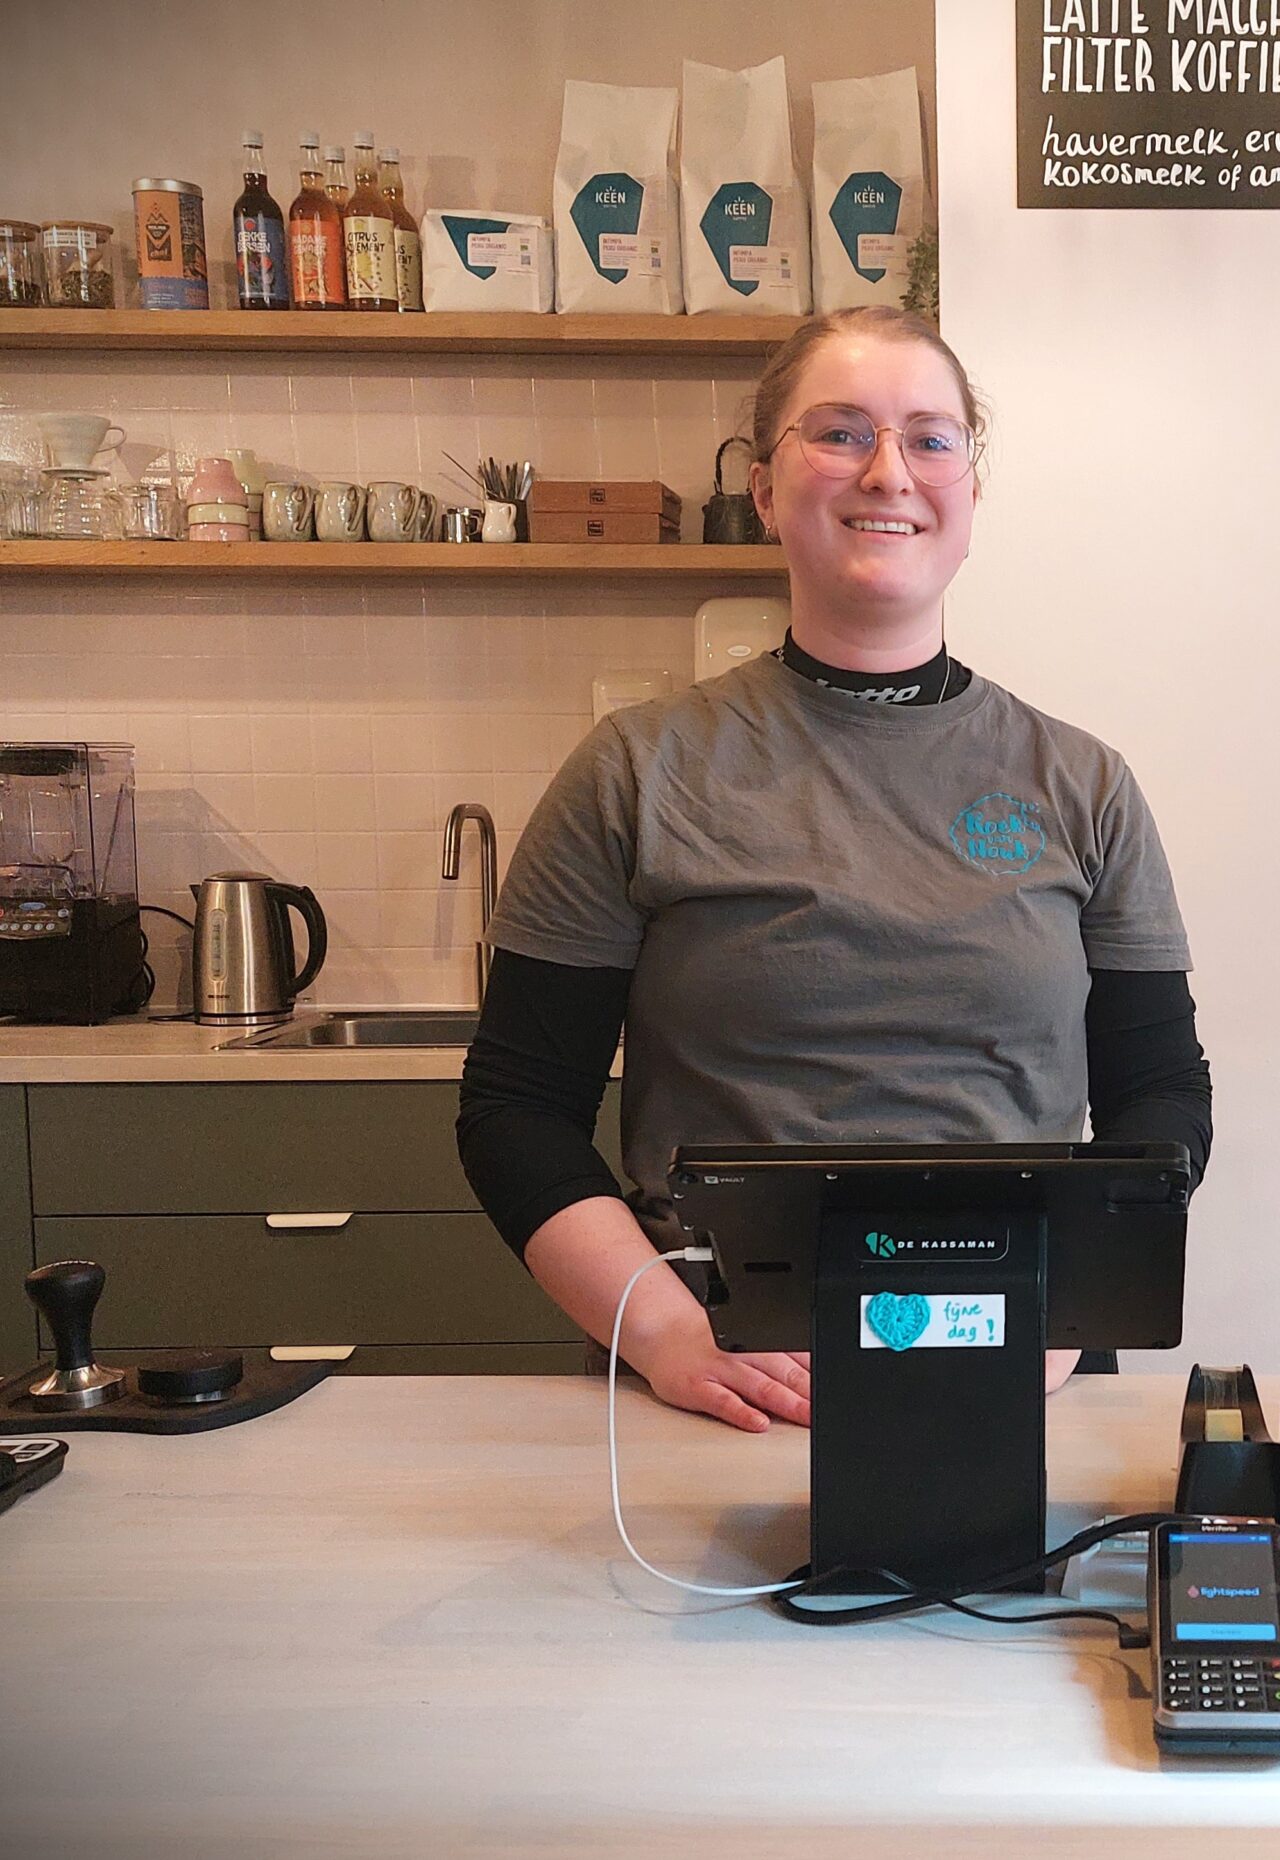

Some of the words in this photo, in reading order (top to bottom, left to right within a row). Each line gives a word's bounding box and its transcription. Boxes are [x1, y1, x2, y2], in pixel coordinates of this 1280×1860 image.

[1042, 36, 1155, 93] FILTER
[1218, 164, 1242, 191] of
[897, 1240, 915, 1249] DE
[921, 1240, 995, 1249] KASSAMAN
[1200, 1586, 1260, 1599] lightspeed
